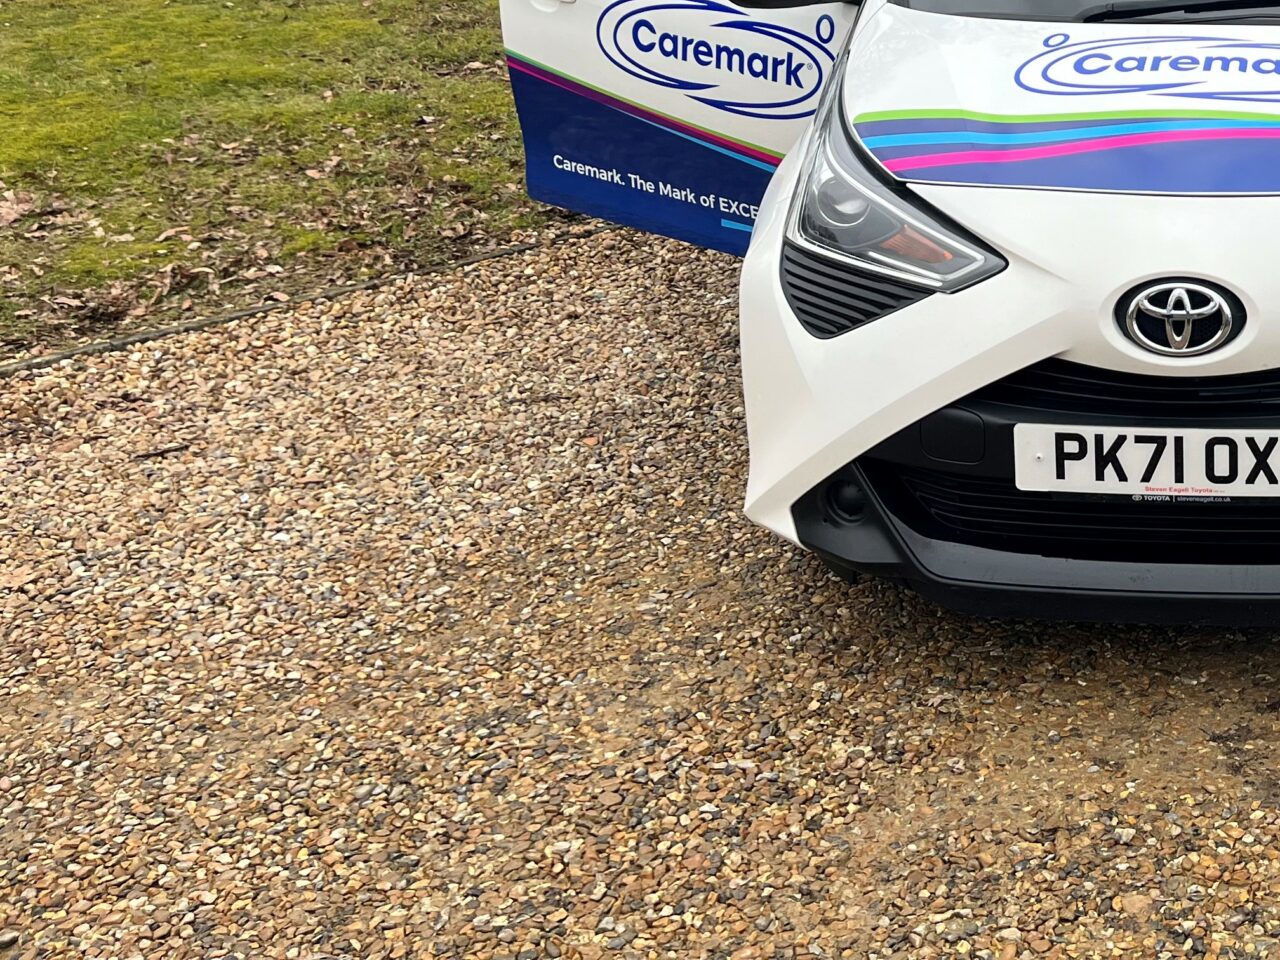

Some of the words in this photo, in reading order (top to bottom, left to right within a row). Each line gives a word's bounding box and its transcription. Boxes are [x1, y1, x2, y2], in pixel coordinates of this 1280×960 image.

[632, 19, 805, 88] Caremark
[553, 154, 626, 186] Caremark.
[628, 174, 655, 193] The
[659, 182, 697, 204] Mark
[699, 194, 716, 208] of
[1054, 431, 1185, 484] PK71
[1144, 495, 1171, 503] TOYOTA
[1191, 487, 1213, 496] Toyota
